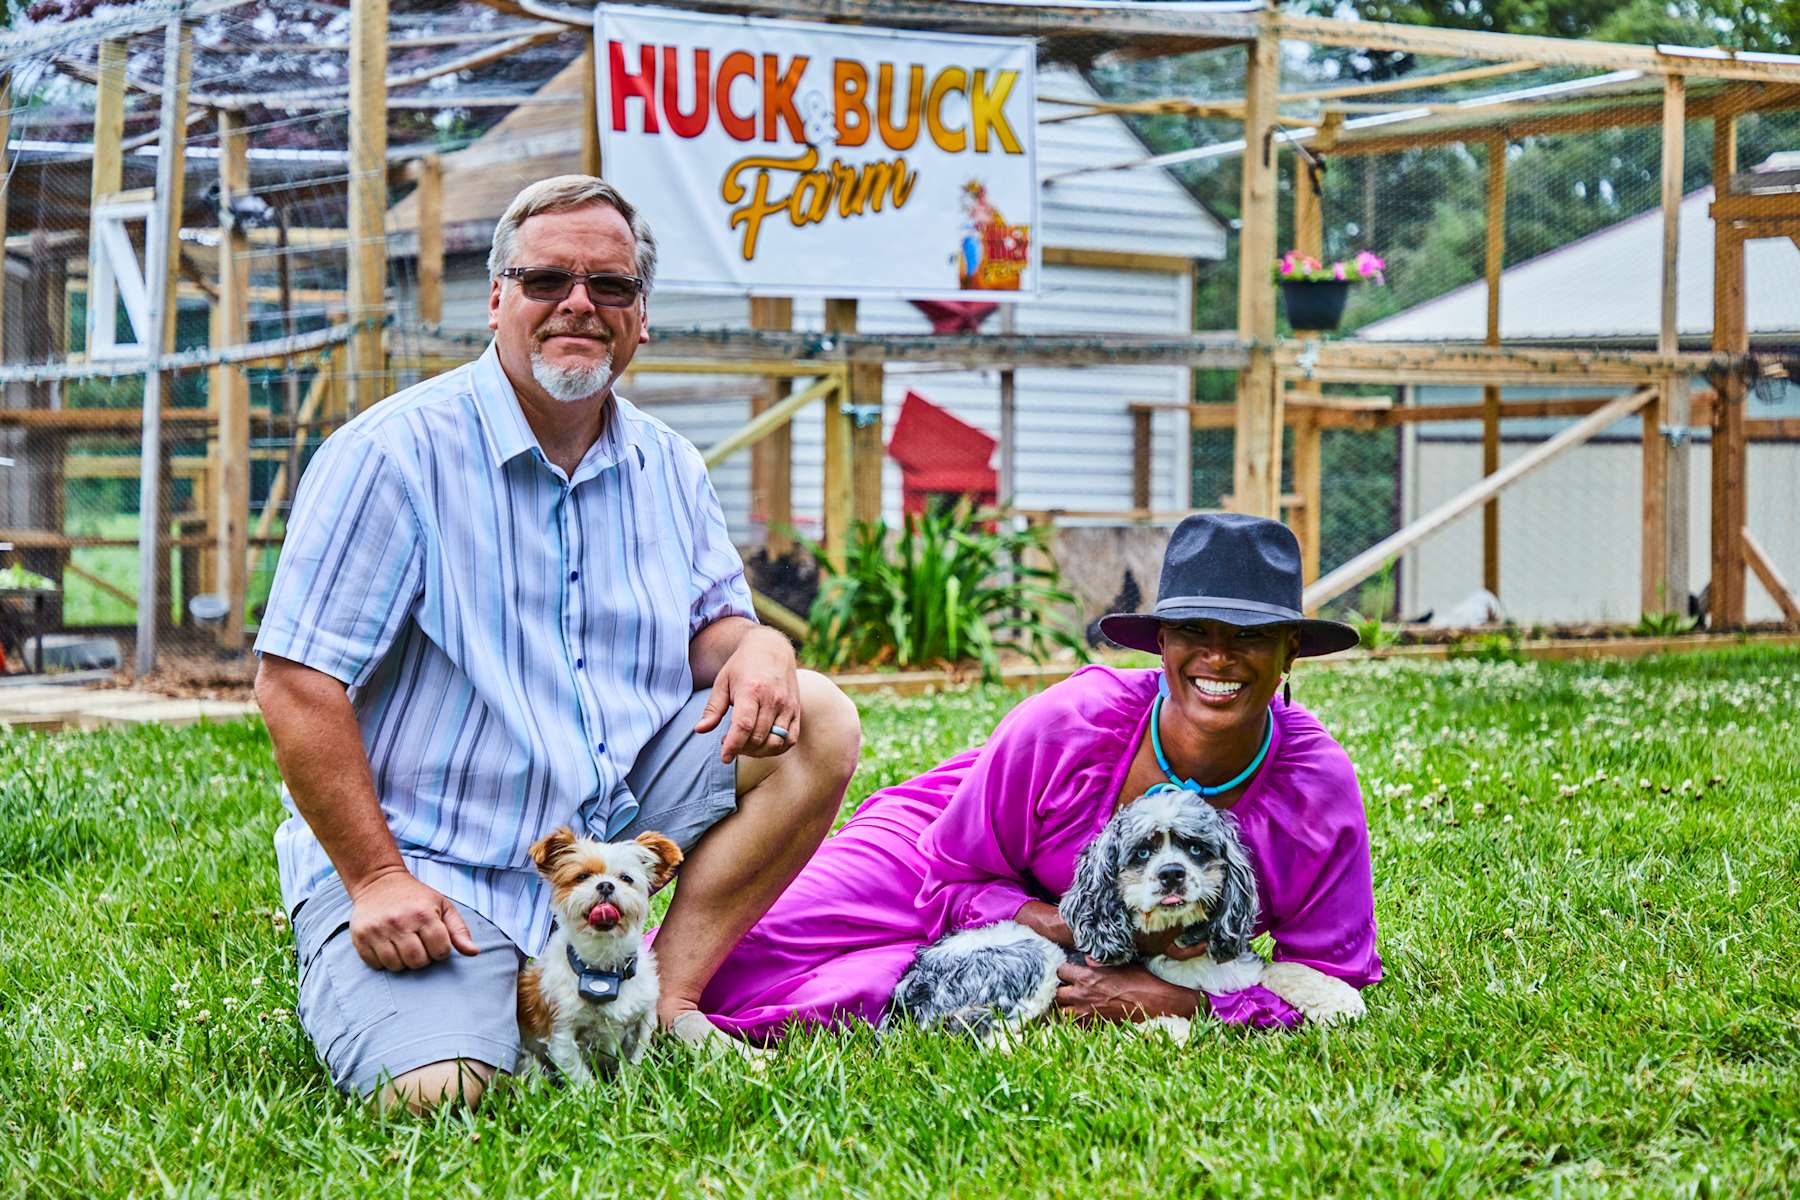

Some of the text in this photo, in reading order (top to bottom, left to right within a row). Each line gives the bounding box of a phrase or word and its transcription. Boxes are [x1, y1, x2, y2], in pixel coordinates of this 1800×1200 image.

[608, 40, 1024, 155] HUCK & BUCK
[721, 145, 918, 261] Farm
